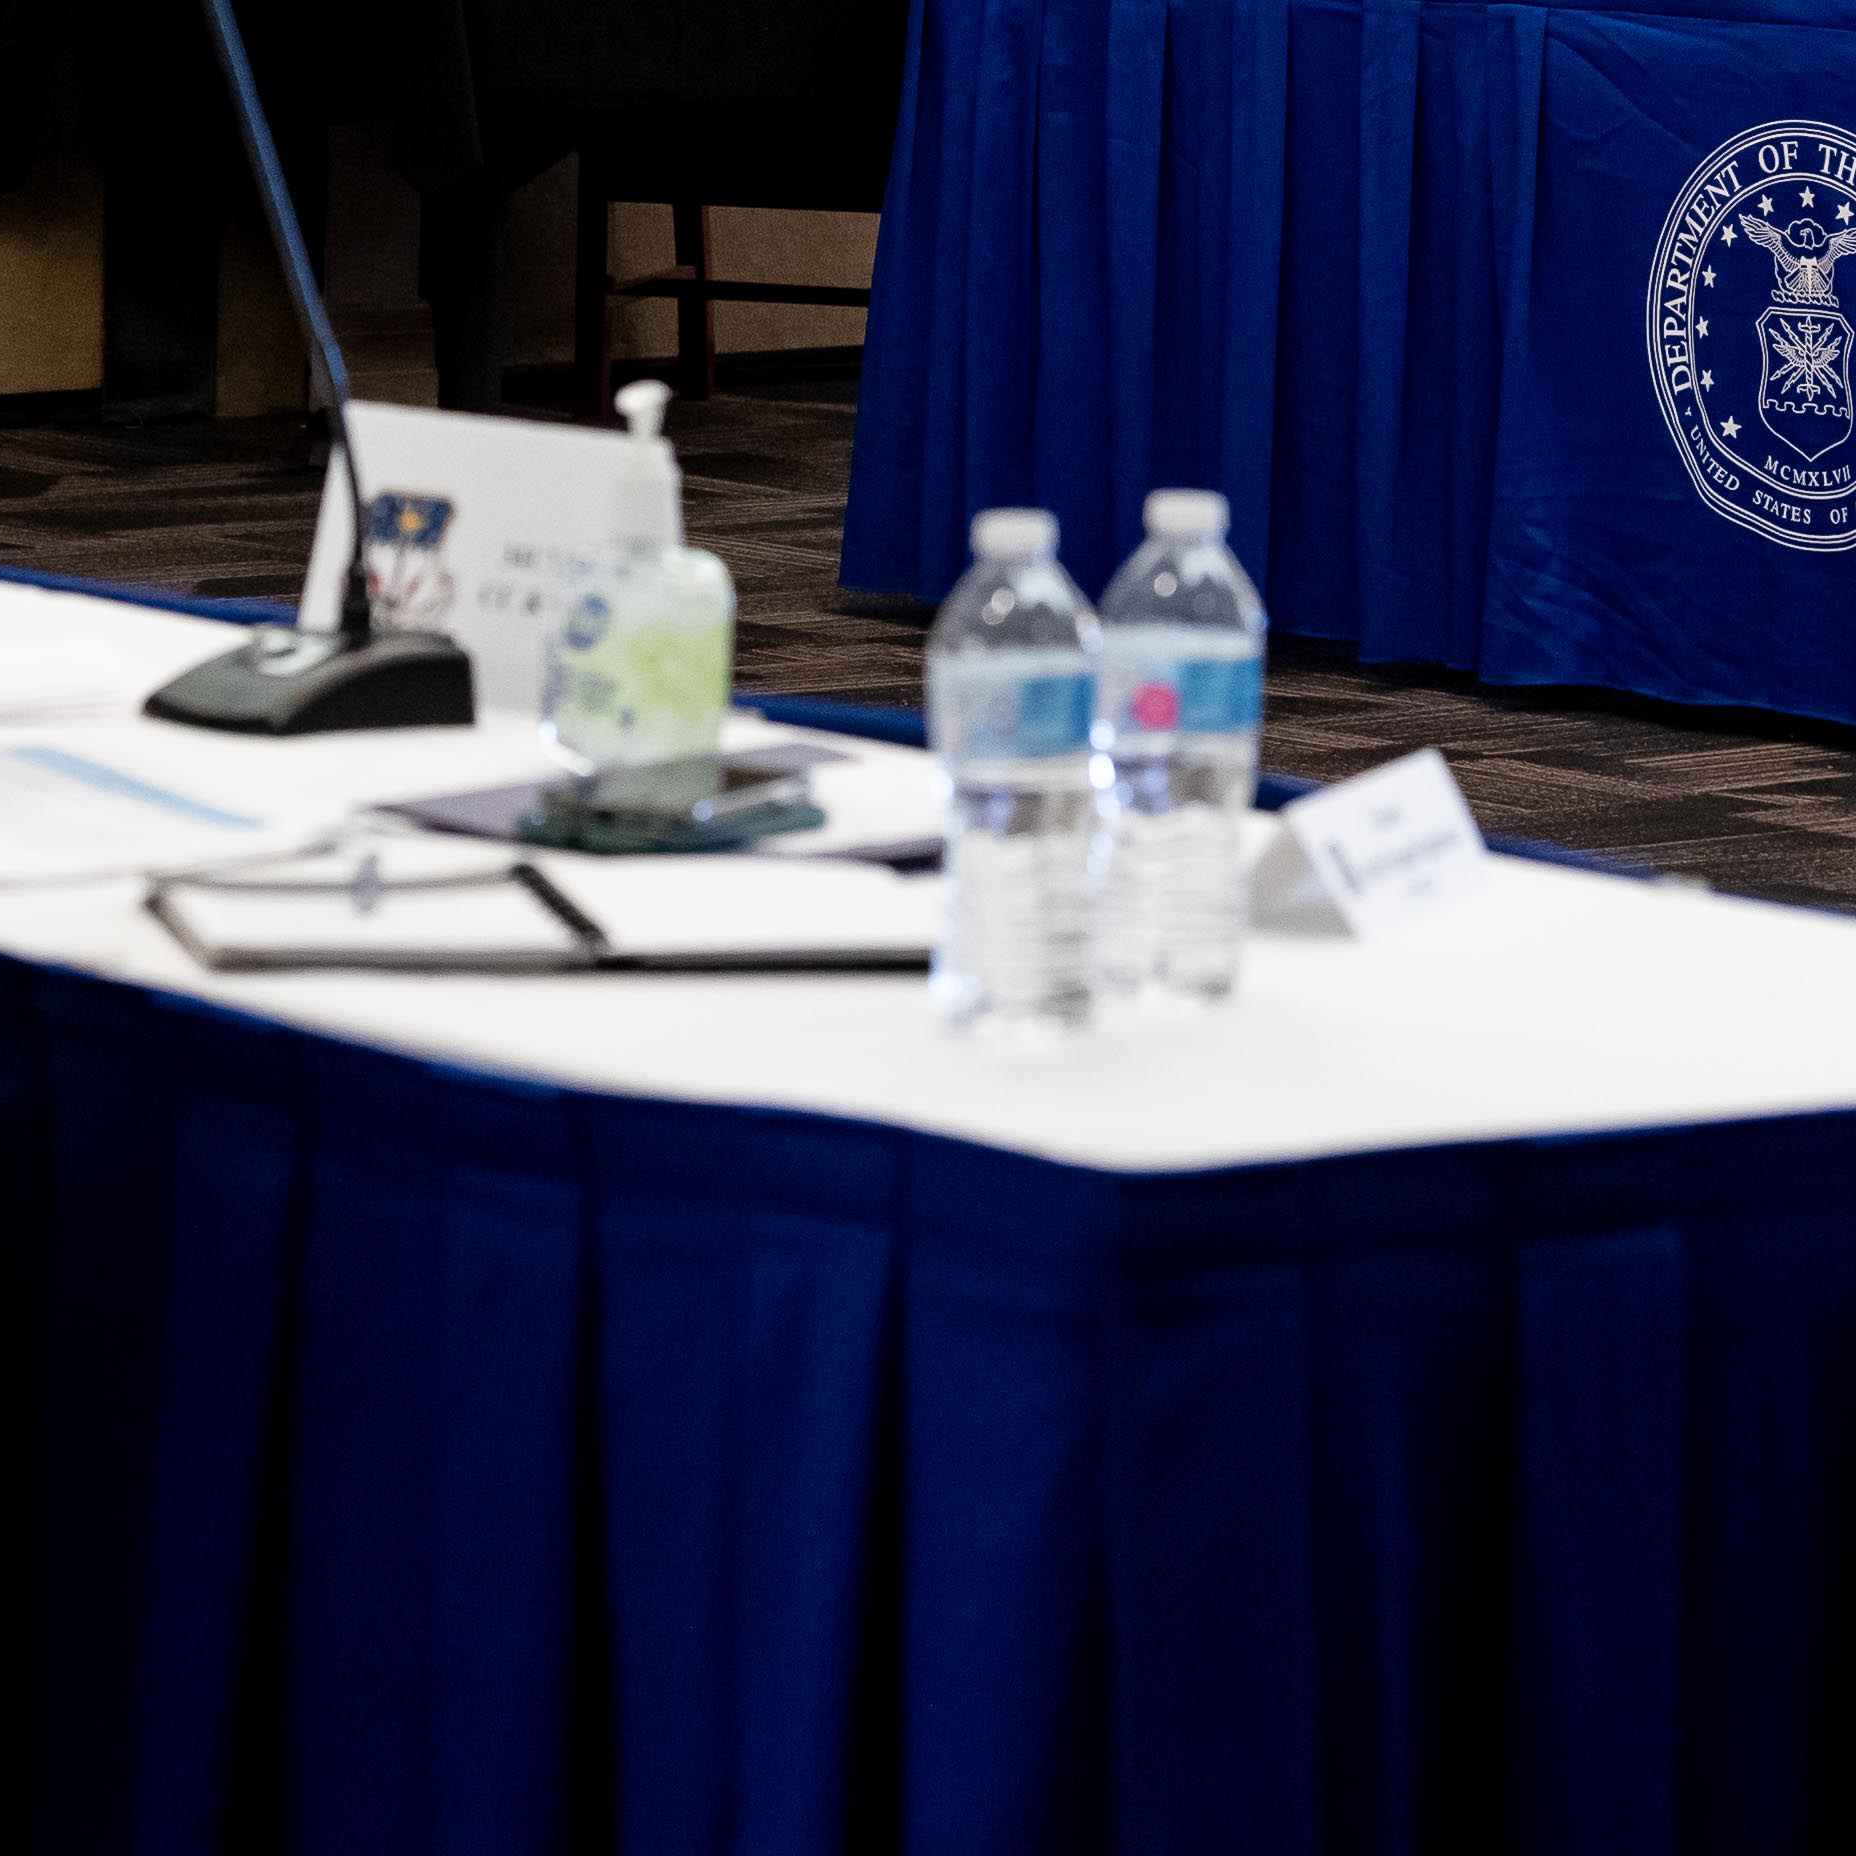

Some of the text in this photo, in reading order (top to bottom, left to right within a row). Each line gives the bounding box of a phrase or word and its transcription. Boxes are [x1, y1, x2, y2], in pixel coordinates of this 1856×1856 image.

[1663, 160, 1742, 395] DEPARTMENT
[1758, 141, 1799, 173] OF
[1690, 424, 1741, 492] UNITED
[1752, 490, 1812, 525] STATES
[1830, 506, 1849, 525] OF
[1763, 455, 1851, 488] MCMXLVII
